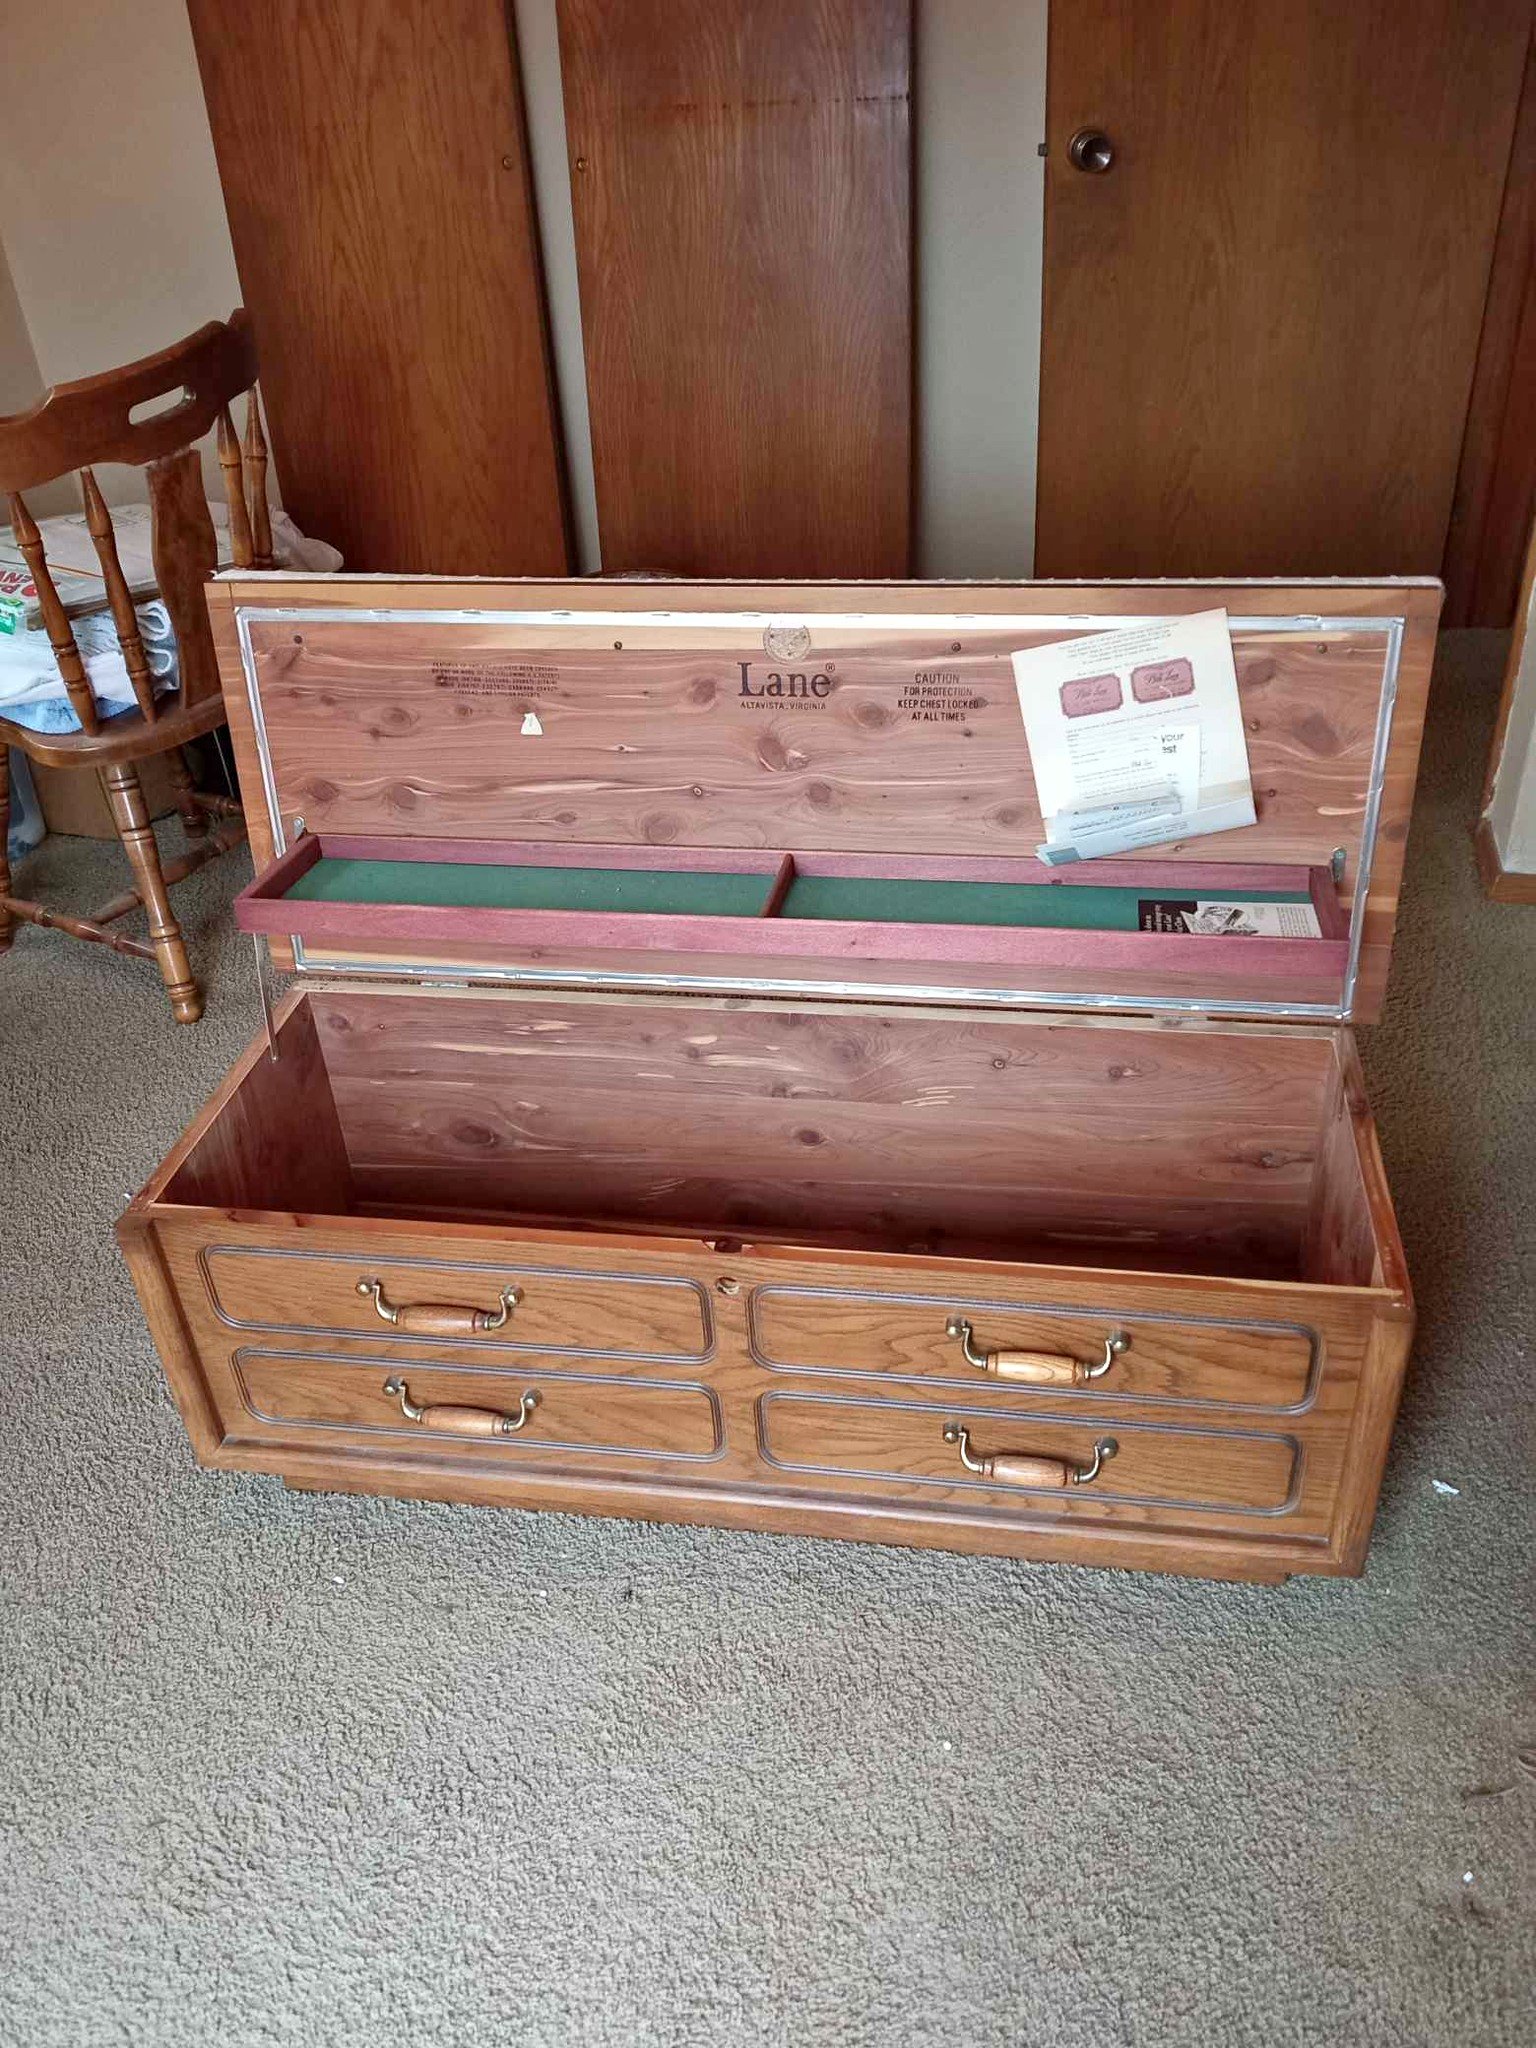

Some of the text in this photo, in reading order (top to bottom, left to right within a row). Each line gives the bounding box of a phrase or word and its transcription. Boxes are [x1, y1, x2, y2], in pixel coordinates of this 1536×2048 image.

[914, 673, 960, 684] CAUTION
[904, 686, 973, 697] FOR PROTECTION
[790, 702, 826, 711] VIRGINIA
[897, 699, 979, 710] KEEP CHEST LOCKED
[912, 712, 966, 722] AT ALL TIMES
